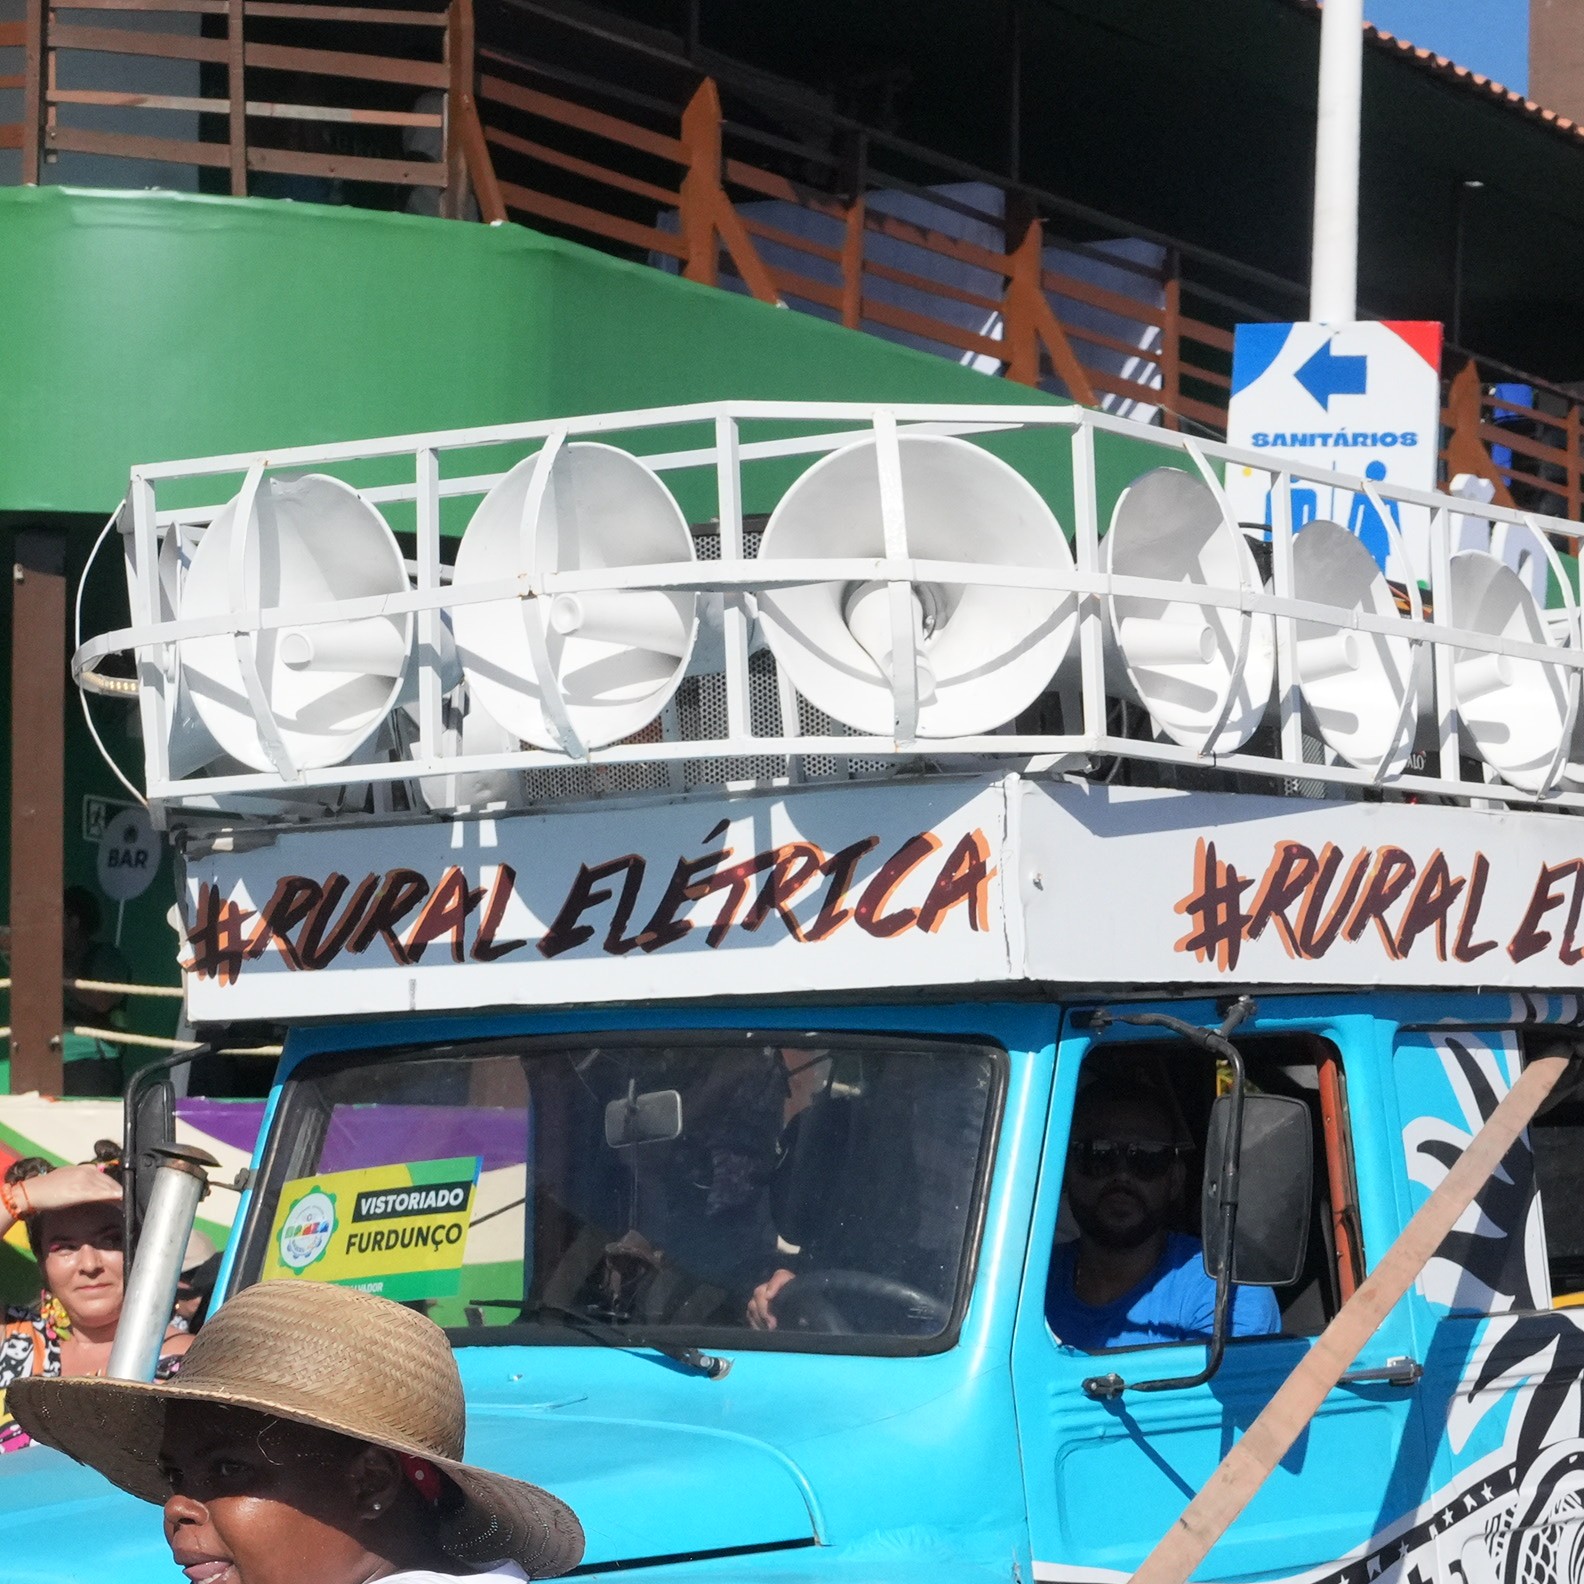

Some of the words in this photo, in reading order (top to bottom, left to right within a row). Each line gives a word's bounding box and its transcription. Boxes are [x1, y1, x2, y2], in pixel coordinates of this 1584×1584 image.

[1252, 428, 1418, 447] SANITÁRIOS
[108, 848, 147, 868] BAR
[179, 862, 527, 987] #RURAL
[536, 818, 998, 959] ELÉTRICA
[1174, 837, 1498, 972] #RURAL
[361, 1187, 464, 1216] VISTORIADO
[346, 1223, 463, 1255] FURDUNÇO
